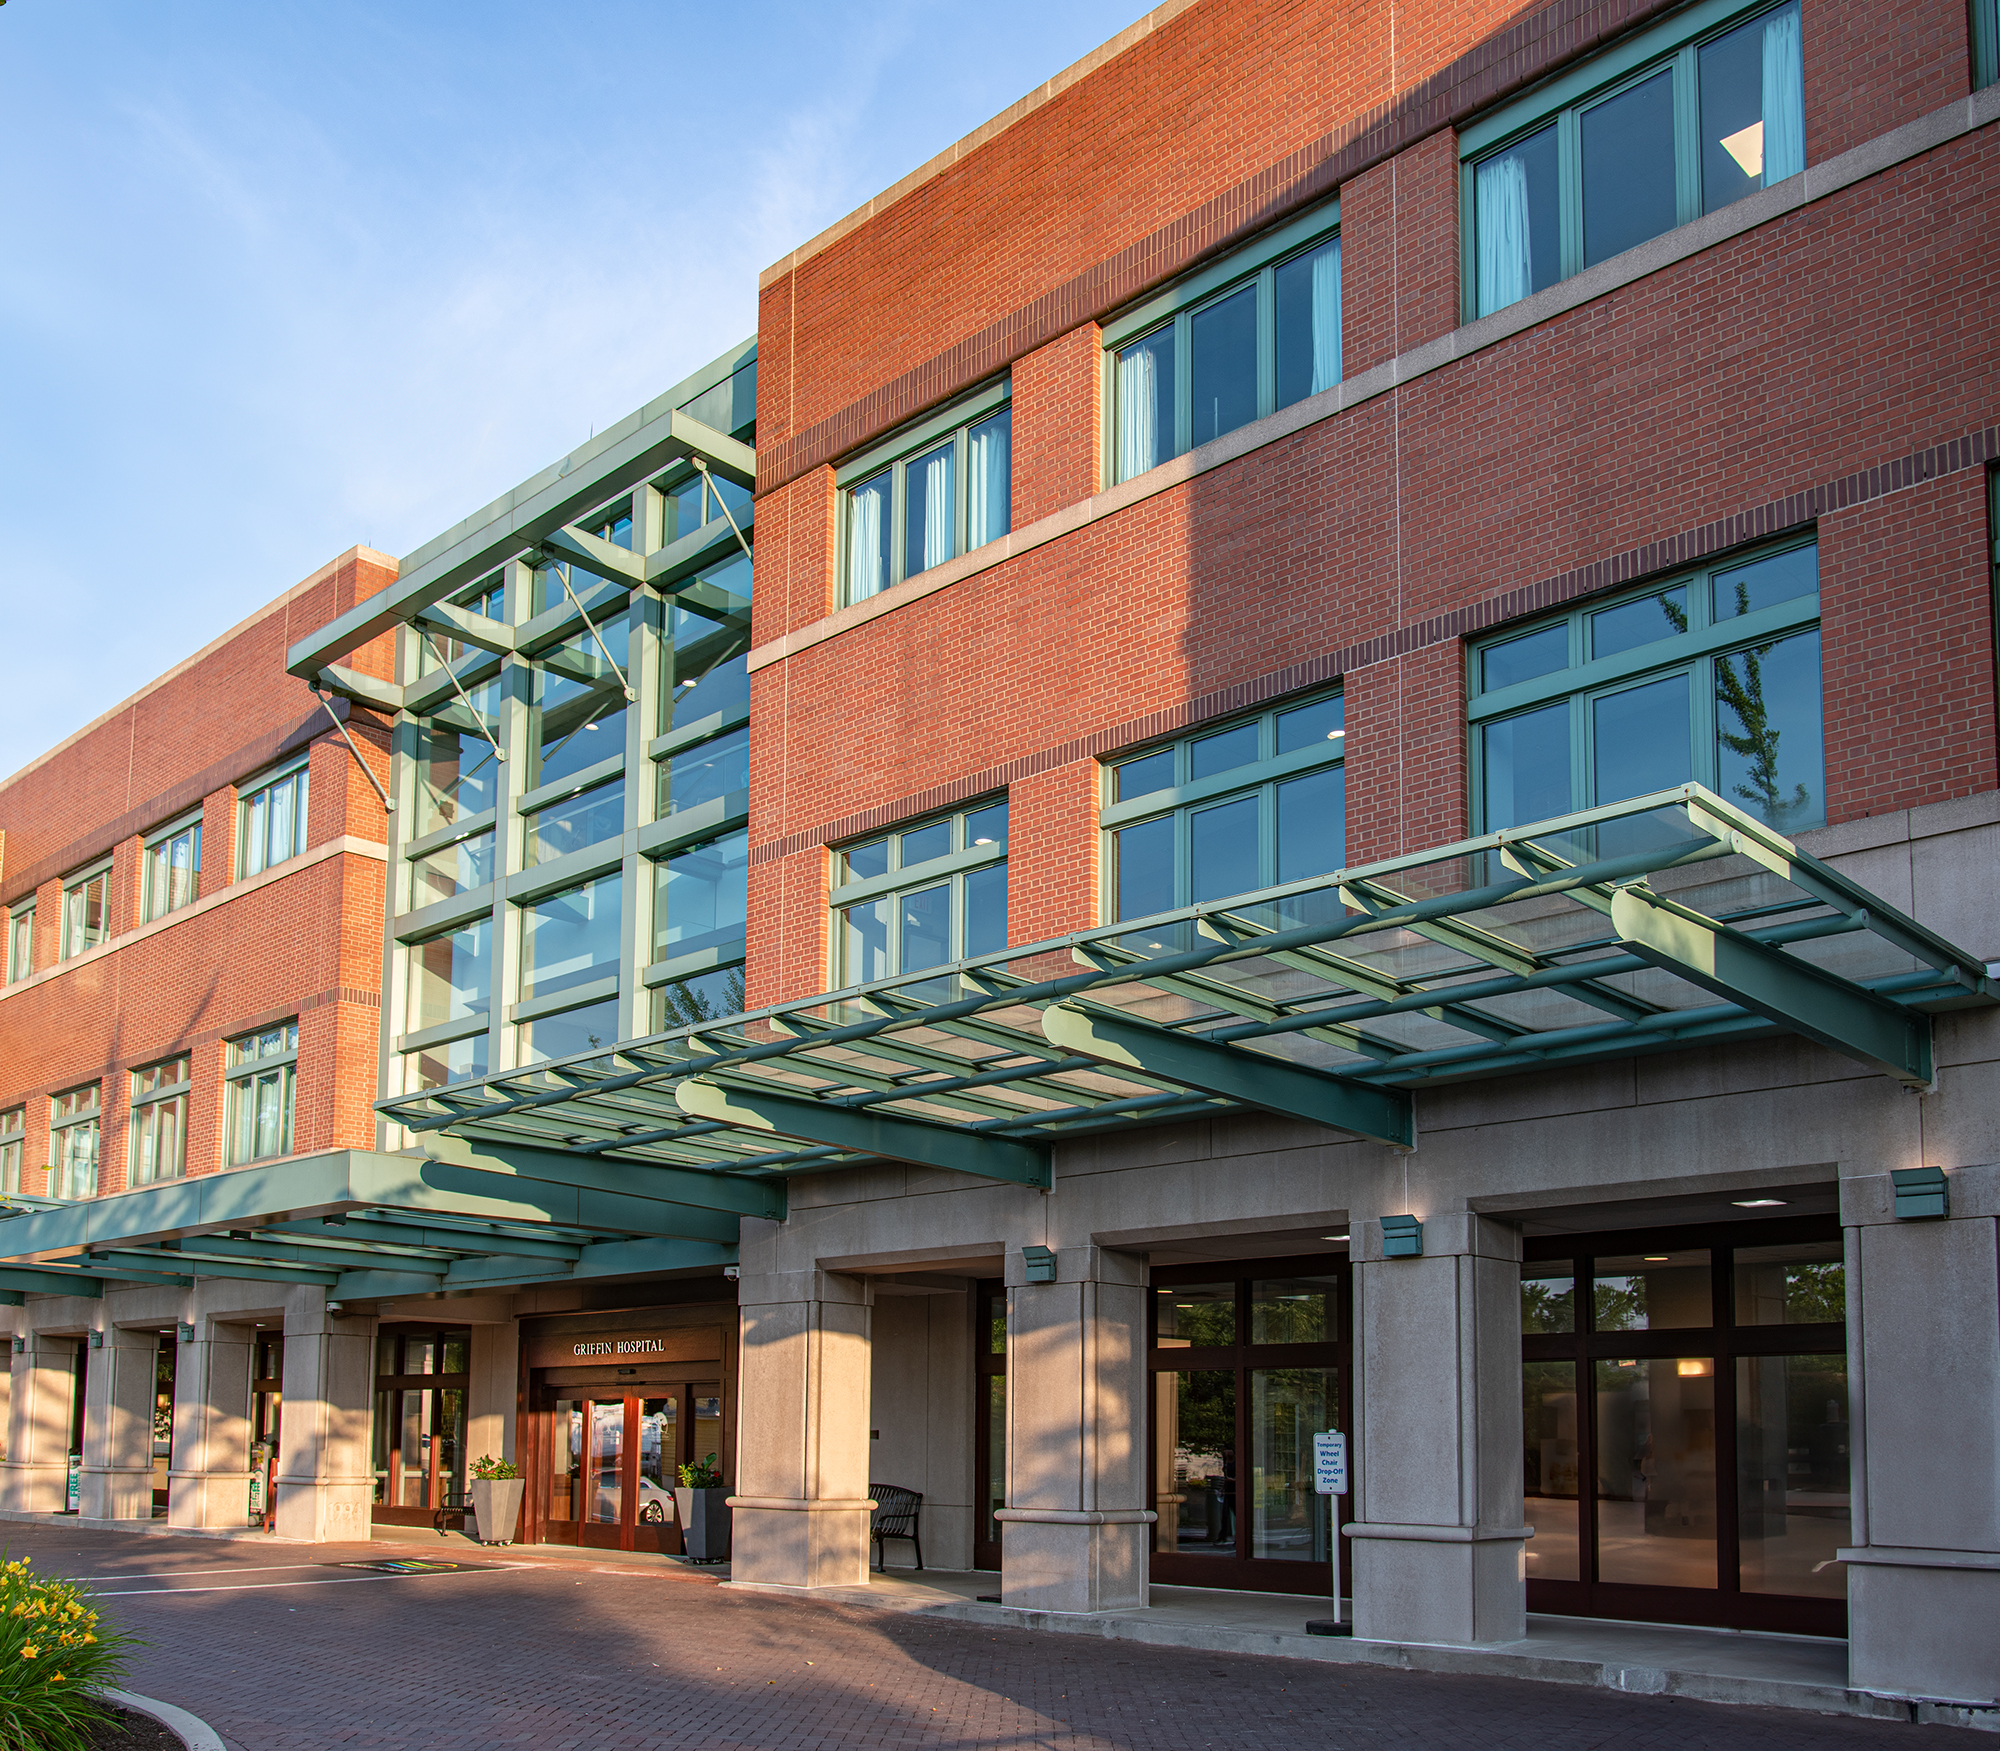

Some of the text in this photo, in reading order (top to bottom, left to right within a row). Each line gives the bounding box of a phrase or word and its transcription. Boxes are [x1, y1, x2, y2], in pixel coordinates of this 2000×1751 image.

[914, 895, 929, 911] EXIT
[573, 1339, 664, 1355] GRIFFIN HOSPITAL
[70, 1473, 78, 1497] FREE
